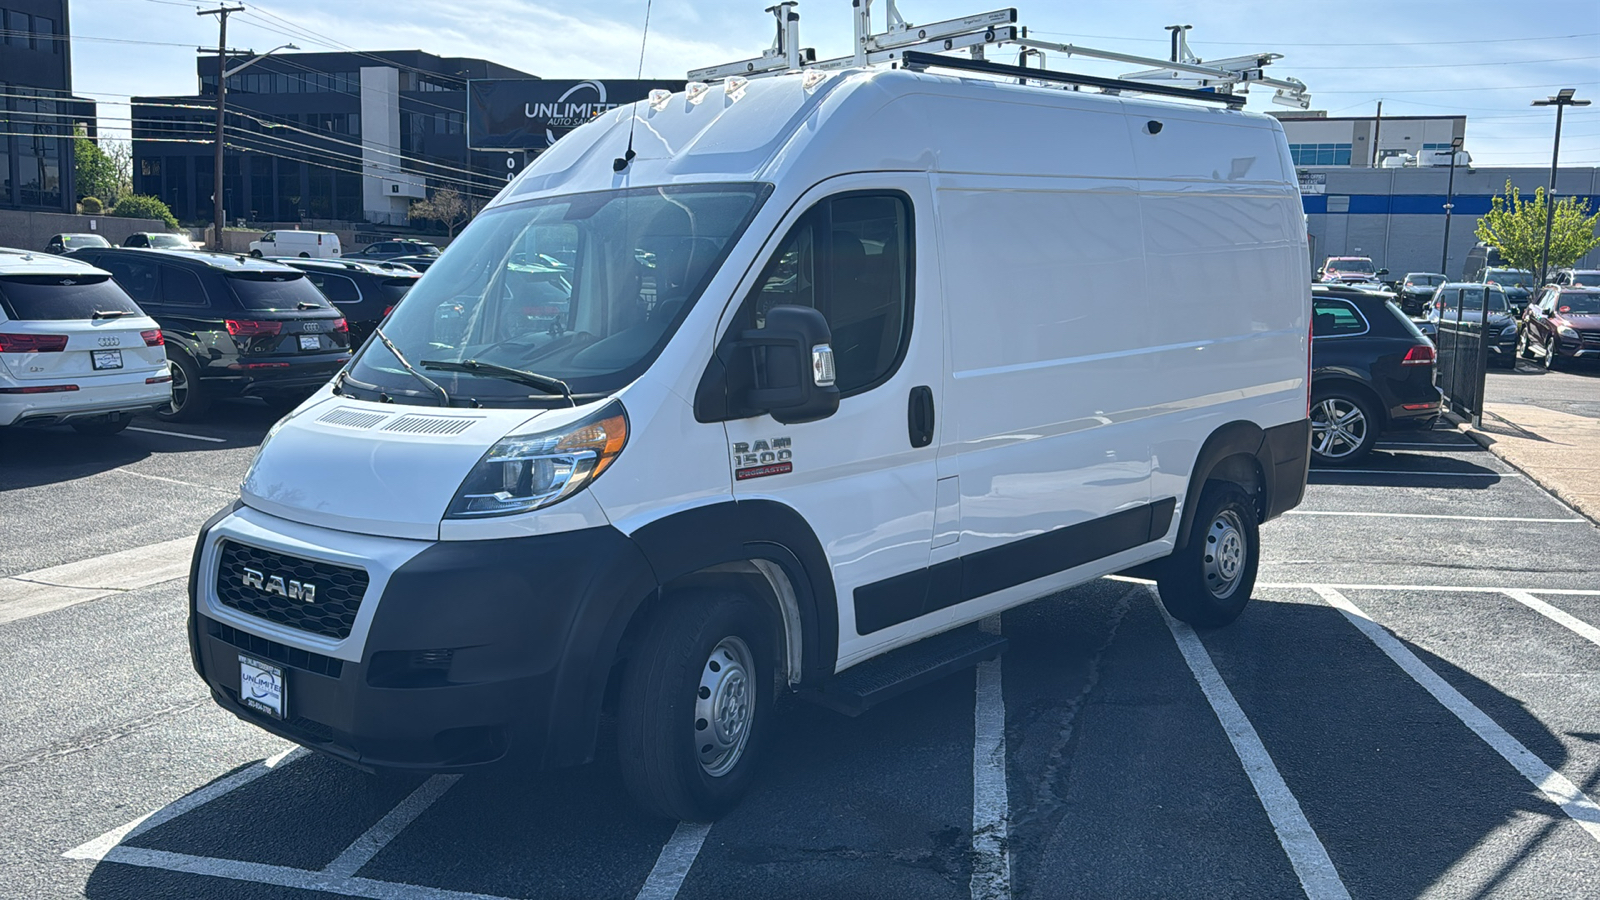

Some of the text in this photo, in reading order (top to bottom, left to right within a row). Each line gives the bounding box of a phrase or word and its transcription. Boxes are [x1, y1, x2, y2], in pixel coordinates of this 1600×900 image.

[525, 103, 618, 118] UNLIMIT
[733, 437, 791, 454] RAM
[734, 449, 792, 467] 1500
[738, 466, 790, 478] PROMASTER
[242, 567, 316, 603] RAM
